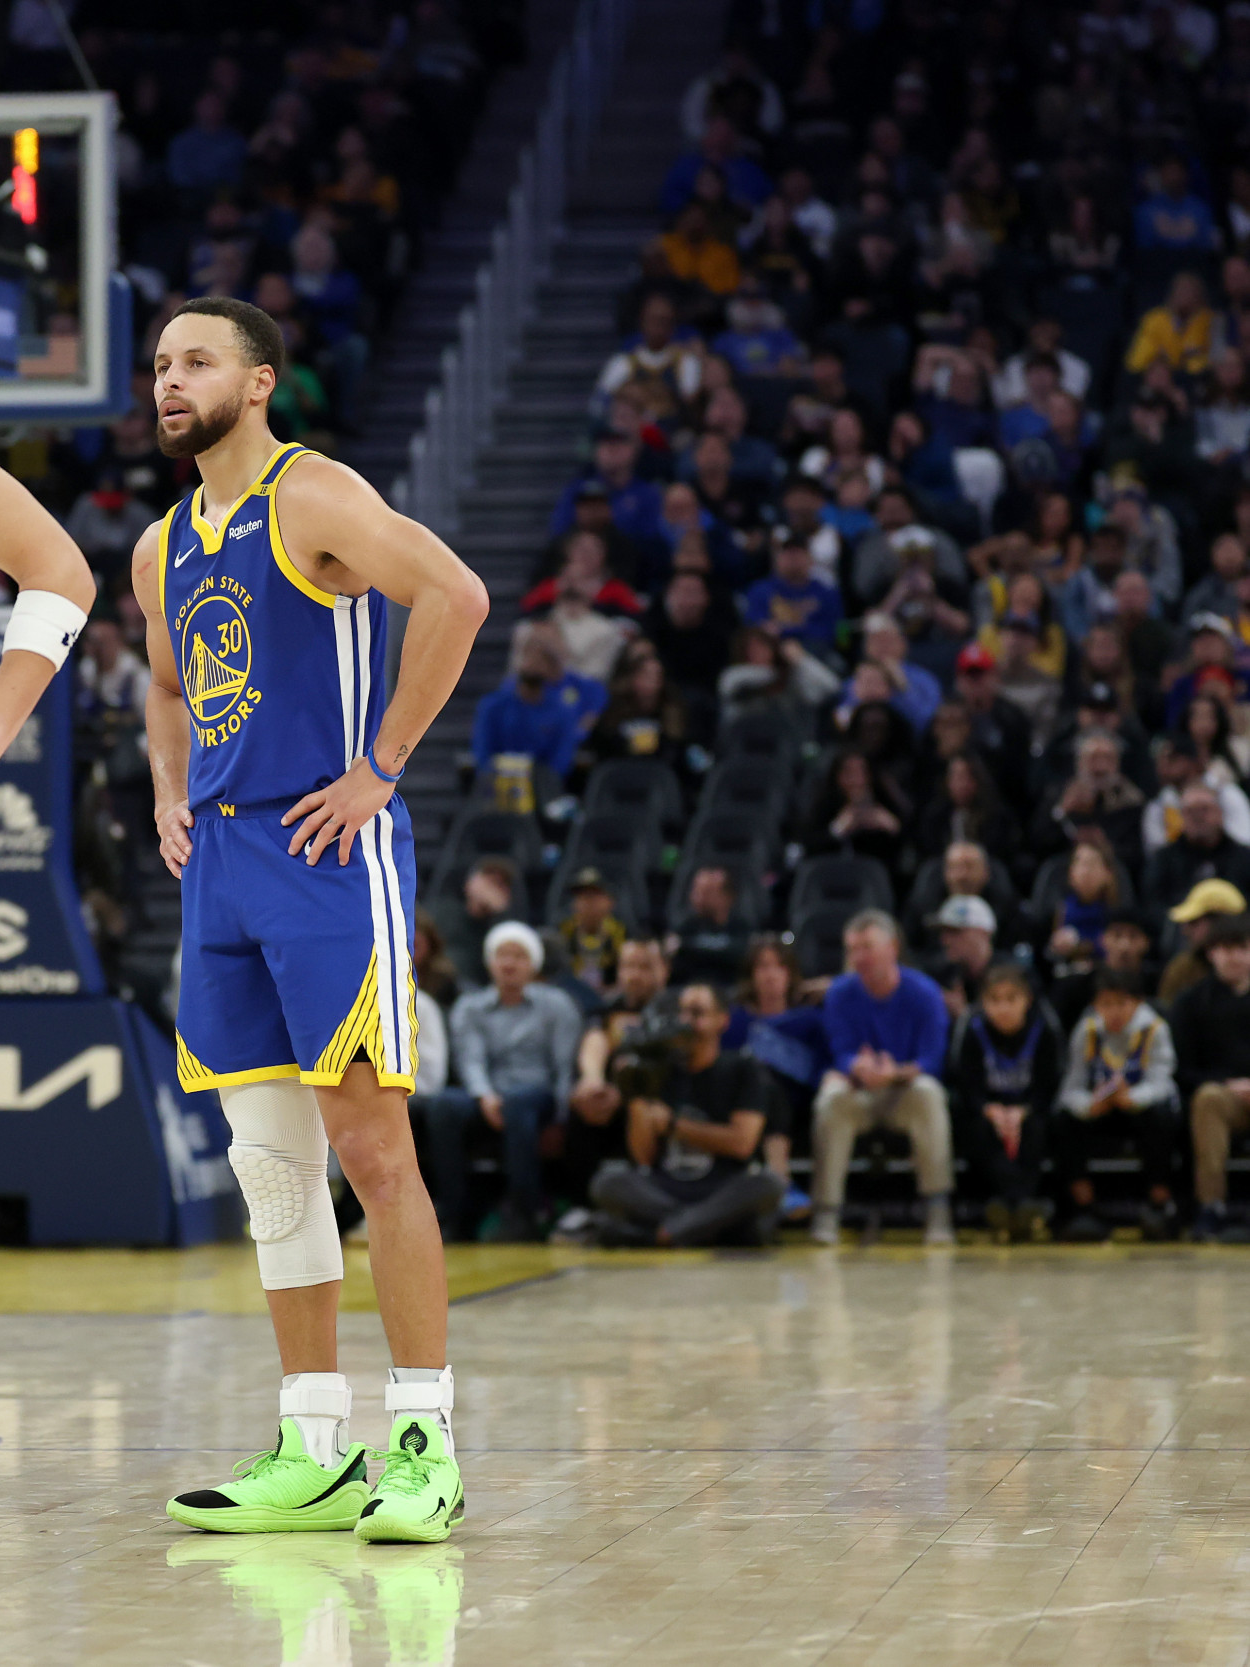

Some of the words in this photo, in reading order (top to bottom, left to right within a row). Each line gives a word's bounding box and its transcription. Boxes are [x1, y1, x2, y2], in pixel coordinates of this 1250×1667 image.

[228, 519, 263, 539] Rakuten
[175, 575, 215, 631] GOLDEN
[220, 575, 254, 609] STATE
[217, 618, 242, 659] 30
[217, 802, 236, 817] W
